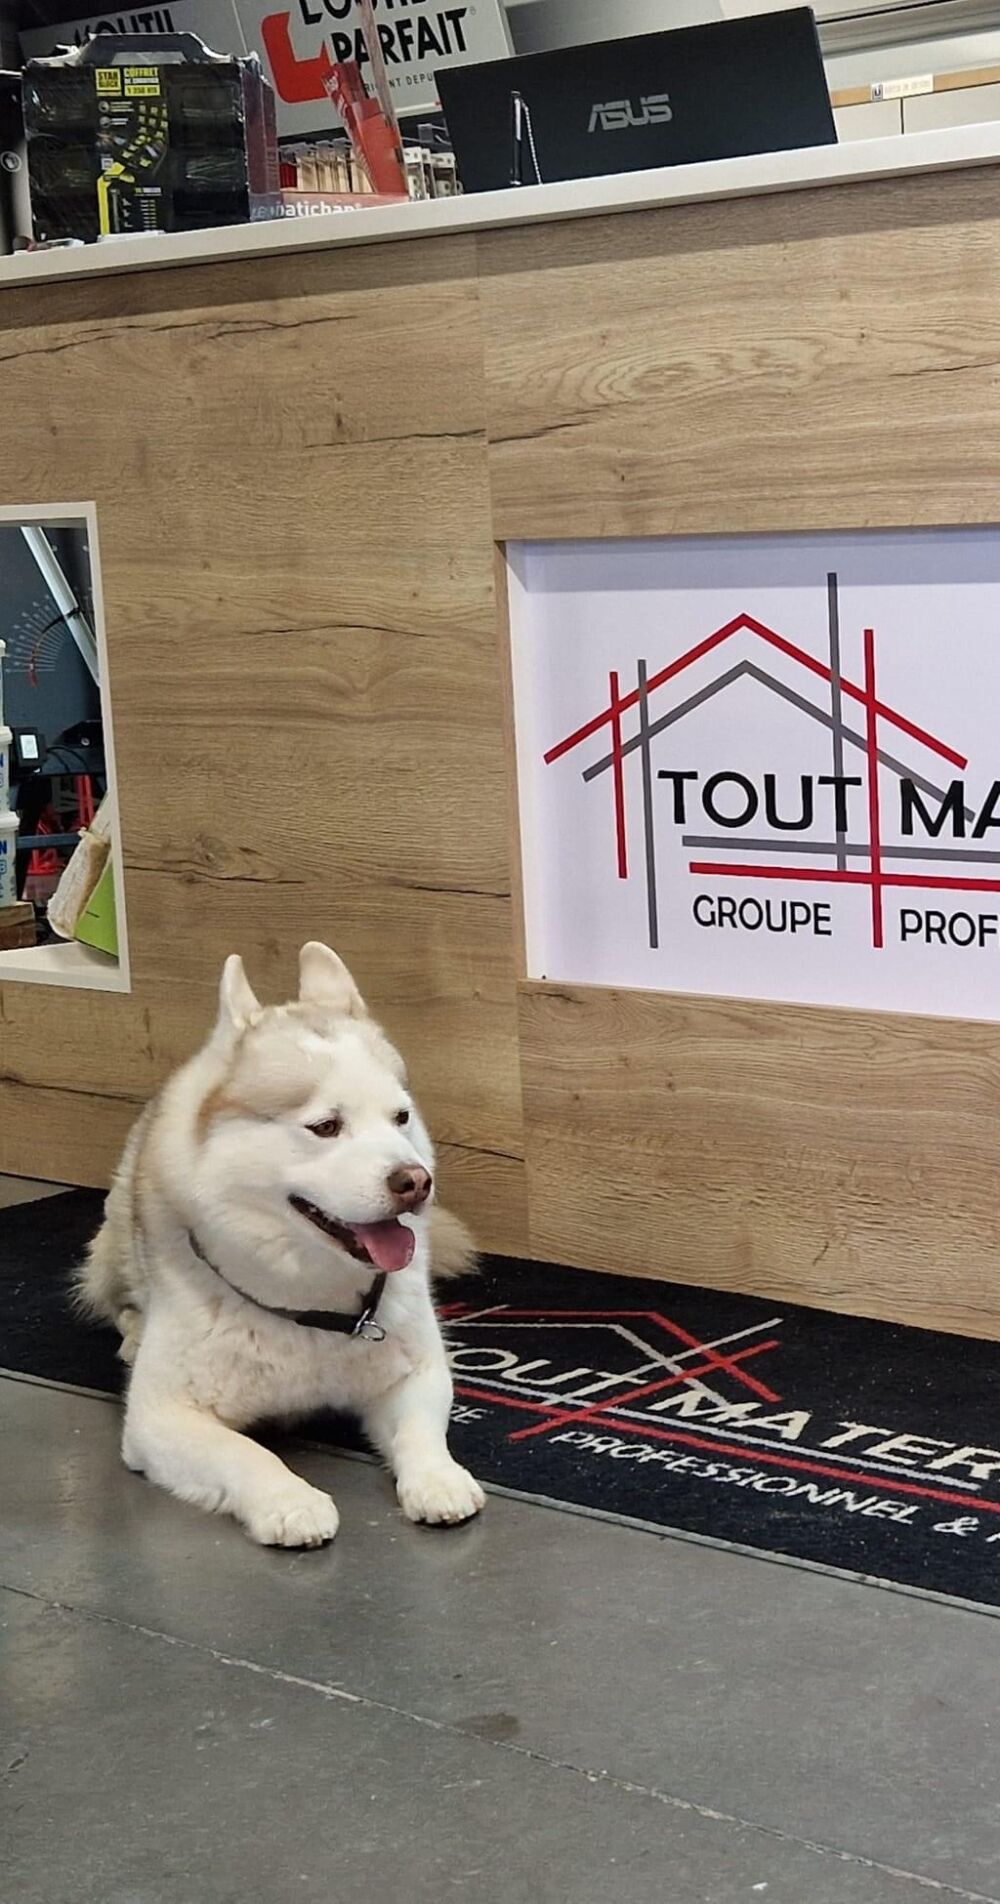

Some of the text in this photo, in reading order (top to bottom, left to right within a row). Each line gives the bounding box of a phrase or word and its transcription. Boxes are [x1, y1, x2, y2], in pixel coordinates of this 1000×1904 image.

[588, 94, 672, 133] ASUS
[657, 769, 862, 833] TOUT
[692, 894, 833, 936] GROUPE
[445, 1339, 649, 1398] OUT
[548, 1430, 921, 1525] PROFESSIONNEL
[933, 1514, 979, 1538] &
